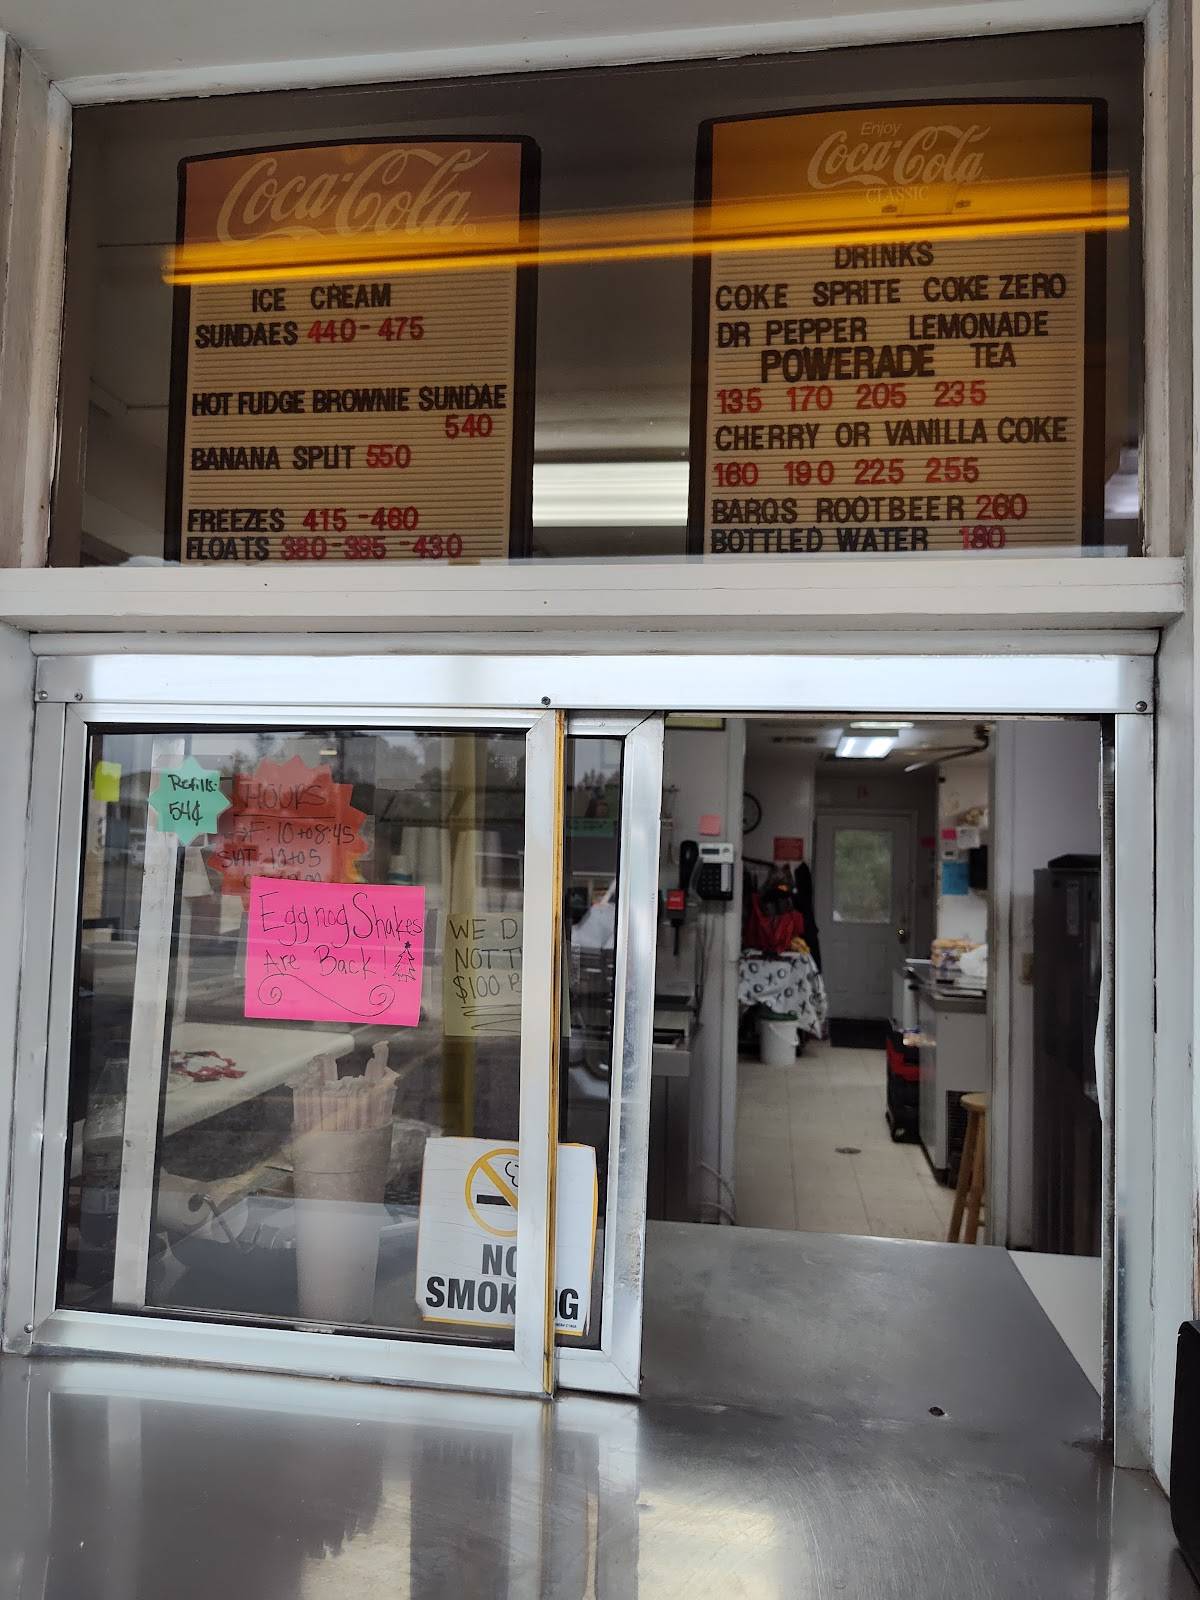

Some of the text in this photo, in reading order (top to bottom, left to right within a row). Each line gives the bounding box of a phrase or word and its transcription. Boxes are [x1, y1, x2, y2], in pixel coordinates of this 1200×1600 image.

[861, 121, 904, 137] Enjoy
[807, 124, 991, 190] Coca-Cola
[216, 149, 489, 247] Coca-Cola
[866, 186, 929, 202] CLASSIC
[834, 240, 935, 270] DRINKS
[251, 282, 392, 313] ICE CREAM
[715, 271, 1068, 312] COKE SPRITE COKE ZERO
[195, 321, 299, 348] SUNDAES
[717, 310, 1049, 349] DR PEPPER LEMONADE
[760, 341, 1017, 384] POWERADE TEA
[191, 384, 507, 417] HOT FUDGE BROWNIE SUNDAE
[716, 379, 987, 414] 135 170 205 235
[444, 412, 494, 440] 540
[715, 415, 1069, 451] CHERRY OR VANILLA COKE
[191, 443, 412, 471] BANANA SPLIT 550
[713, 455, 980, 488] 160 190 225 255
[187, 507, 286, 533] FREEZES
[711, 497, 799, 525] BARQS
[975, 492, 1028, 521] 260
[186, 535, 270, 561] FLOATS
[710, 523, 1008, 554] BOTTLED WATER 180
[244, 782, 327, 811] HOURS
[168, 799, 205, 827] 54¢
[352, 891, 424, 942] Shakes
[449, 917, 519, 941] WE D
[263, 949, 300, 974] Are
[454, 946, 523, 973] NOT T
[452, 972, 522, 1004] $100 B
